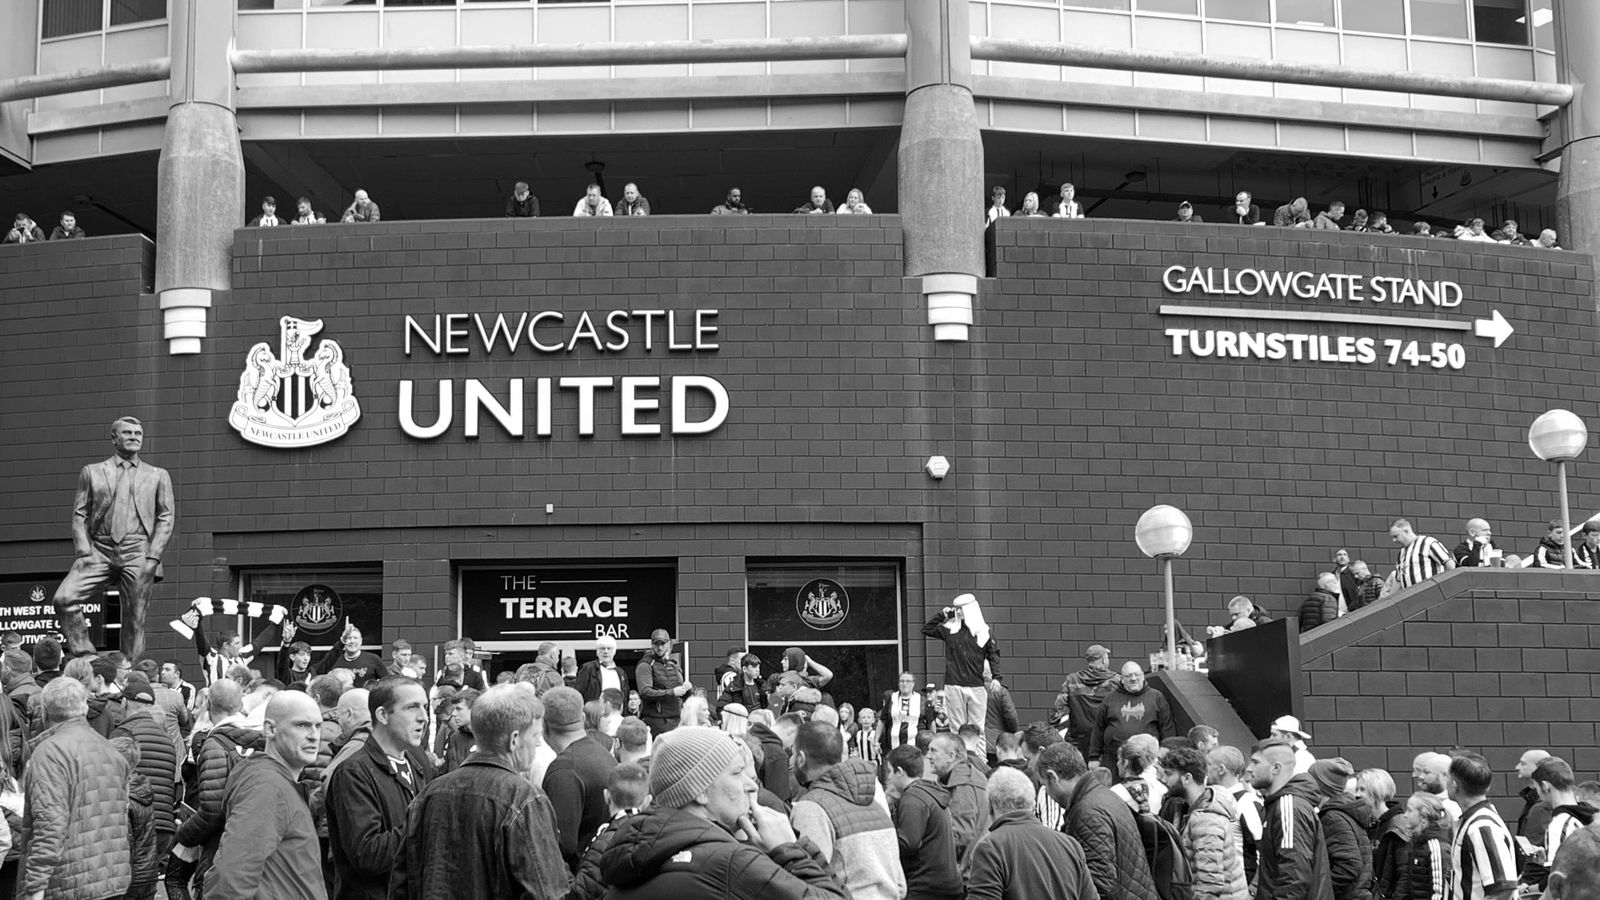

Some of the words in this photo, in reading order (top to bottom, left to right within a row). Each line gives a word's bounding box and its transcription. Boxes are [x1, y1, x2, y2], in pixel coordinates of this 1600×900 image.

[1163, 265, 1364, 302] GALLOWGATE
[1370, 276, 1463, 307] STAND
[405, 309, 719, 354] NEWCASTLE
[1165, 328, 1377, 364] TURNSTILES
[1384, 338, 1466, 370] 74-50
[398, 375, 730, 438] UNITED
[250, 427, 305, 440] NEWCASTLE
[306, 422, 341, 438] UNITED
[500, 575, 537, 590] THE
[13, 606, 42, 616] WEST
[500, 596, 629, 619] TERRACE
[0, 619, 53, 630] LLOWGATE
[595, 623, 630, 638] BAR
